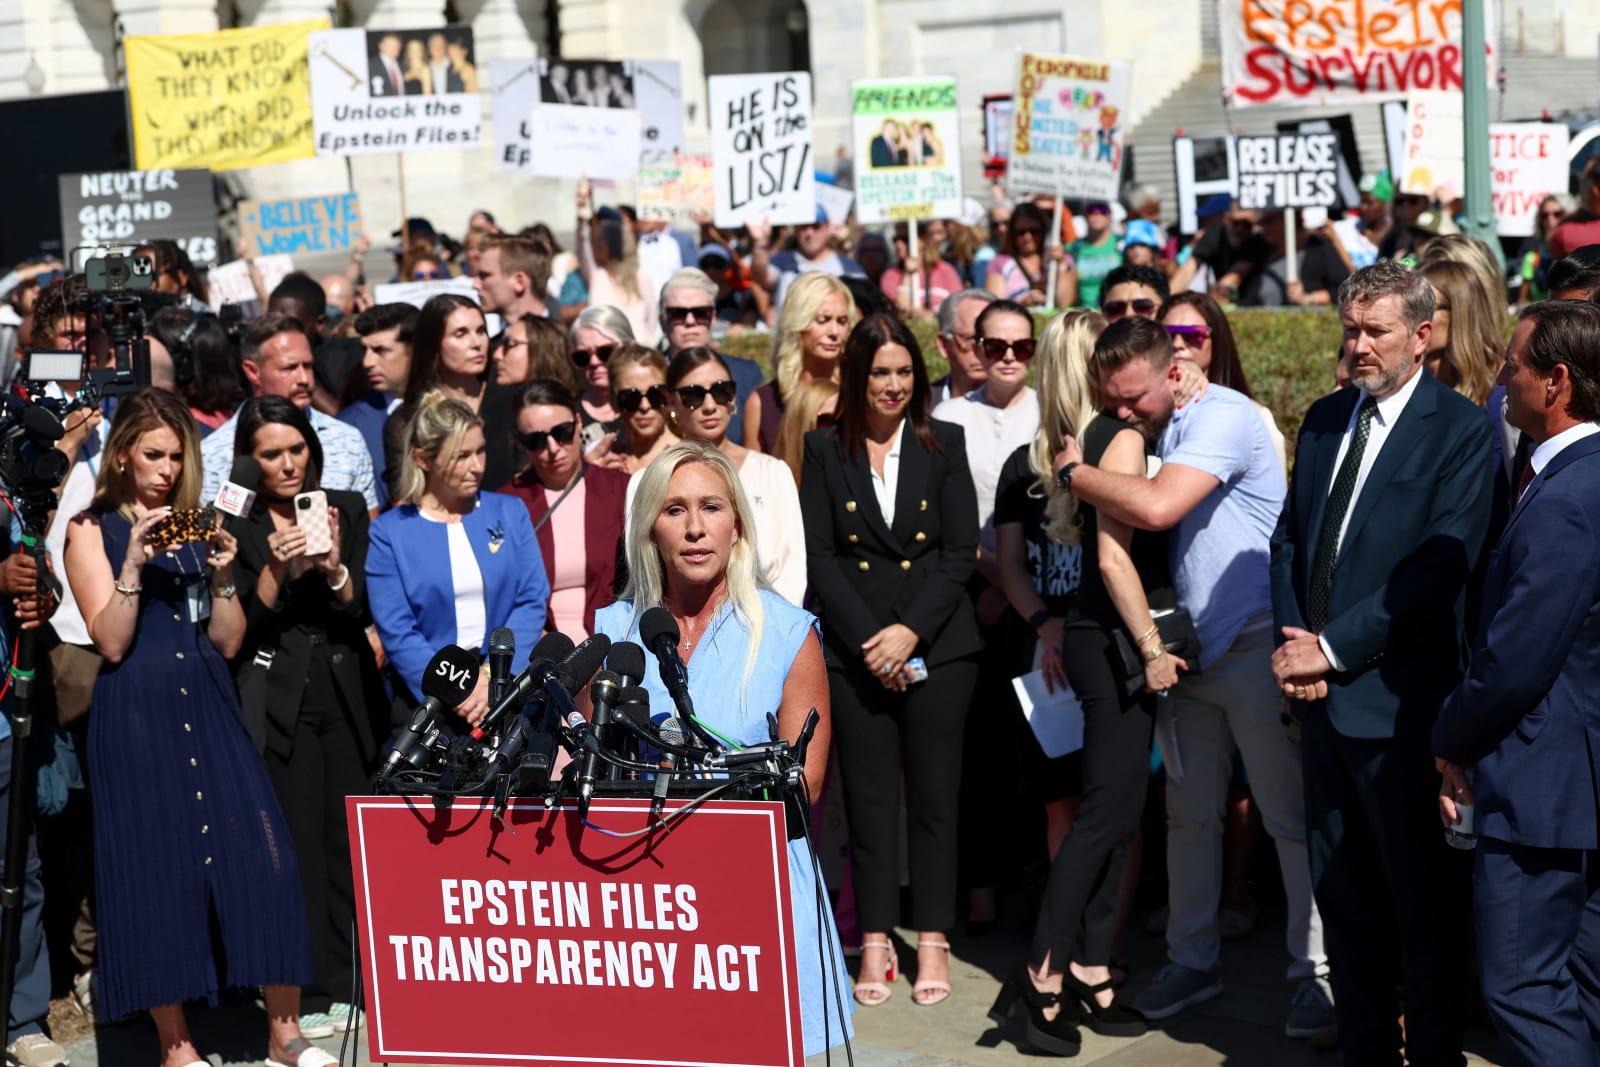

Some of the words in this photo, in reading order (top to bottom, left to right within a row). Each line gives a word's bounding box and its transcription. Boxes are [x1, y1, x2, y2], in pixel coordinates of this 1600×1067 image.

[177, 46, 240, 68] WHAT
[251, 39, 286, 64] DID
[157, 75, 214, 98] THEY
[185, 107, 247, 130] WHEN
[256, 95, 293, 122] DID
[333, 102, 416, 122] Unlock
[423, 100, 463, 117] the
[728, 89, 764, 129] HE
[773, 77, 798, 110] IS
[218, 127, 286, 151] KNOW
[319, 131, 408, 151] Epstein
[414, 124, 481, 145] Files!
[733, 123, 764, 153] ON
[774, 113, 808, 137] the
[1490, 133, 1550, 159] TICE
[1238, 134, 1336, 172] RELEASE
[80, 168, 179, 198] NEUTER
[729, 142, 810, 211] LIST!
[1256, 171, 1336, 208] FILES
[1491, 166, 1519, 184] or
[78, 200, 173, 224] GRAND
[259, 193, 359, 232] BELIEVE
[81, 221, 135, 240] OLD
[256, 223, 350, 256] WOMEN
[435, 660, 471, 690] svt
[441, 878, 591, 928] EPSTEIN
[600, 882, 699, 931] FILES
[389, 935, 679, 989] TRANSPARENCY
[692, 943, 761, 992] ACT
